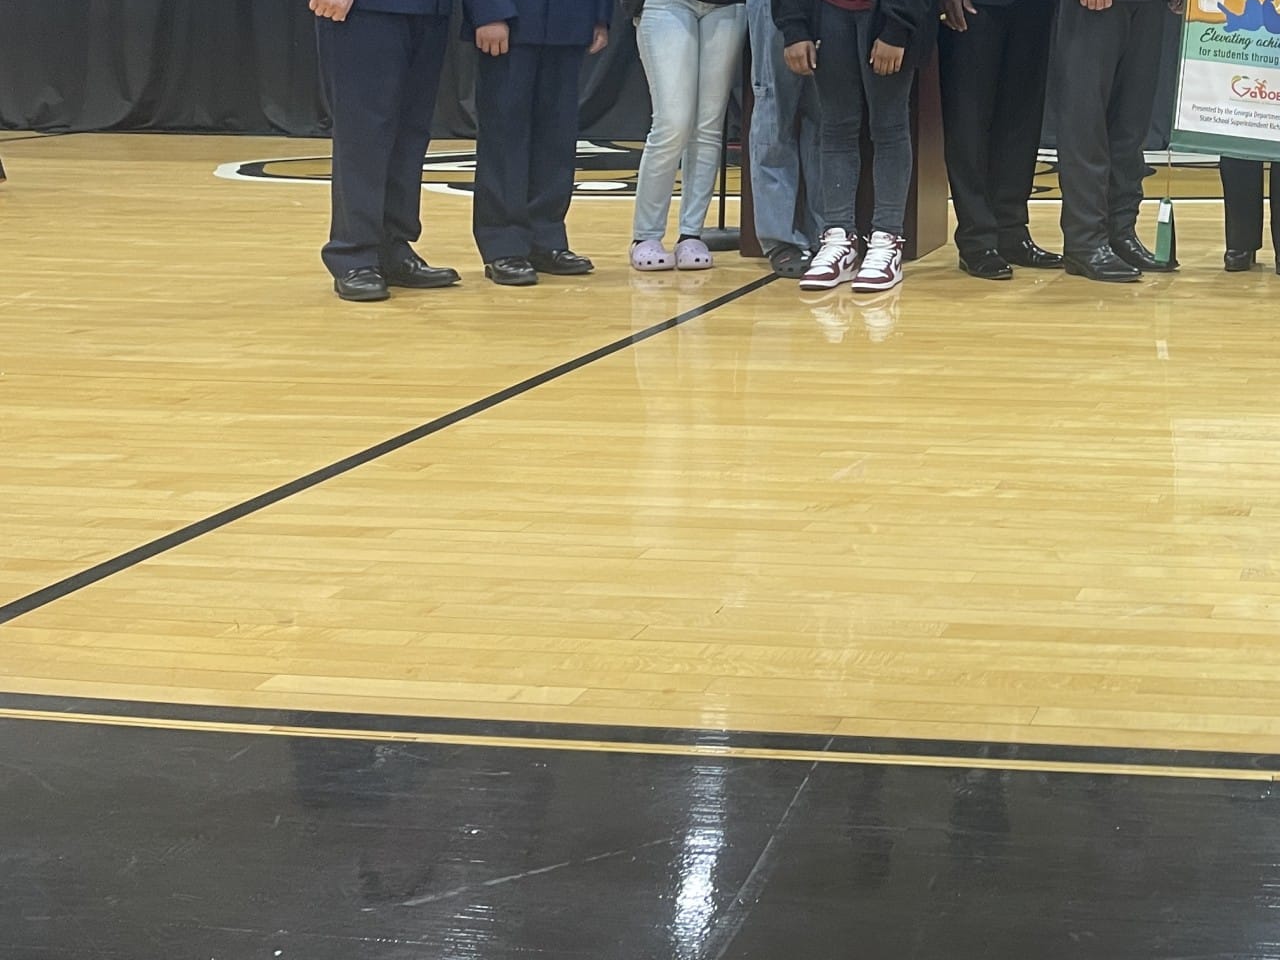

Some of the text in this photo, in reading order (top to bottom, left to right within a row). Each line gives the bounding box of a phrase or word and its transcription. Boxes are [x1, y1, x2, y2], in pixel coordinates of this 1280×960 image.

[1200, 27, 1252, 50] Elevating
[1199, 47, 1211, 56] for
[1213, 48, 1249, 61] students
[1192, 104, 1217, 114] Presented
[1218, 106, 1224, 115] by
[1224, 106, 1233, 115] the
[1234, 108, 1253, 118] Georgia
[1200, 114, 1213, 123] State
[1213, 116, 1230, 125] School
[1231, 117, 1269, 130] Superintendent
